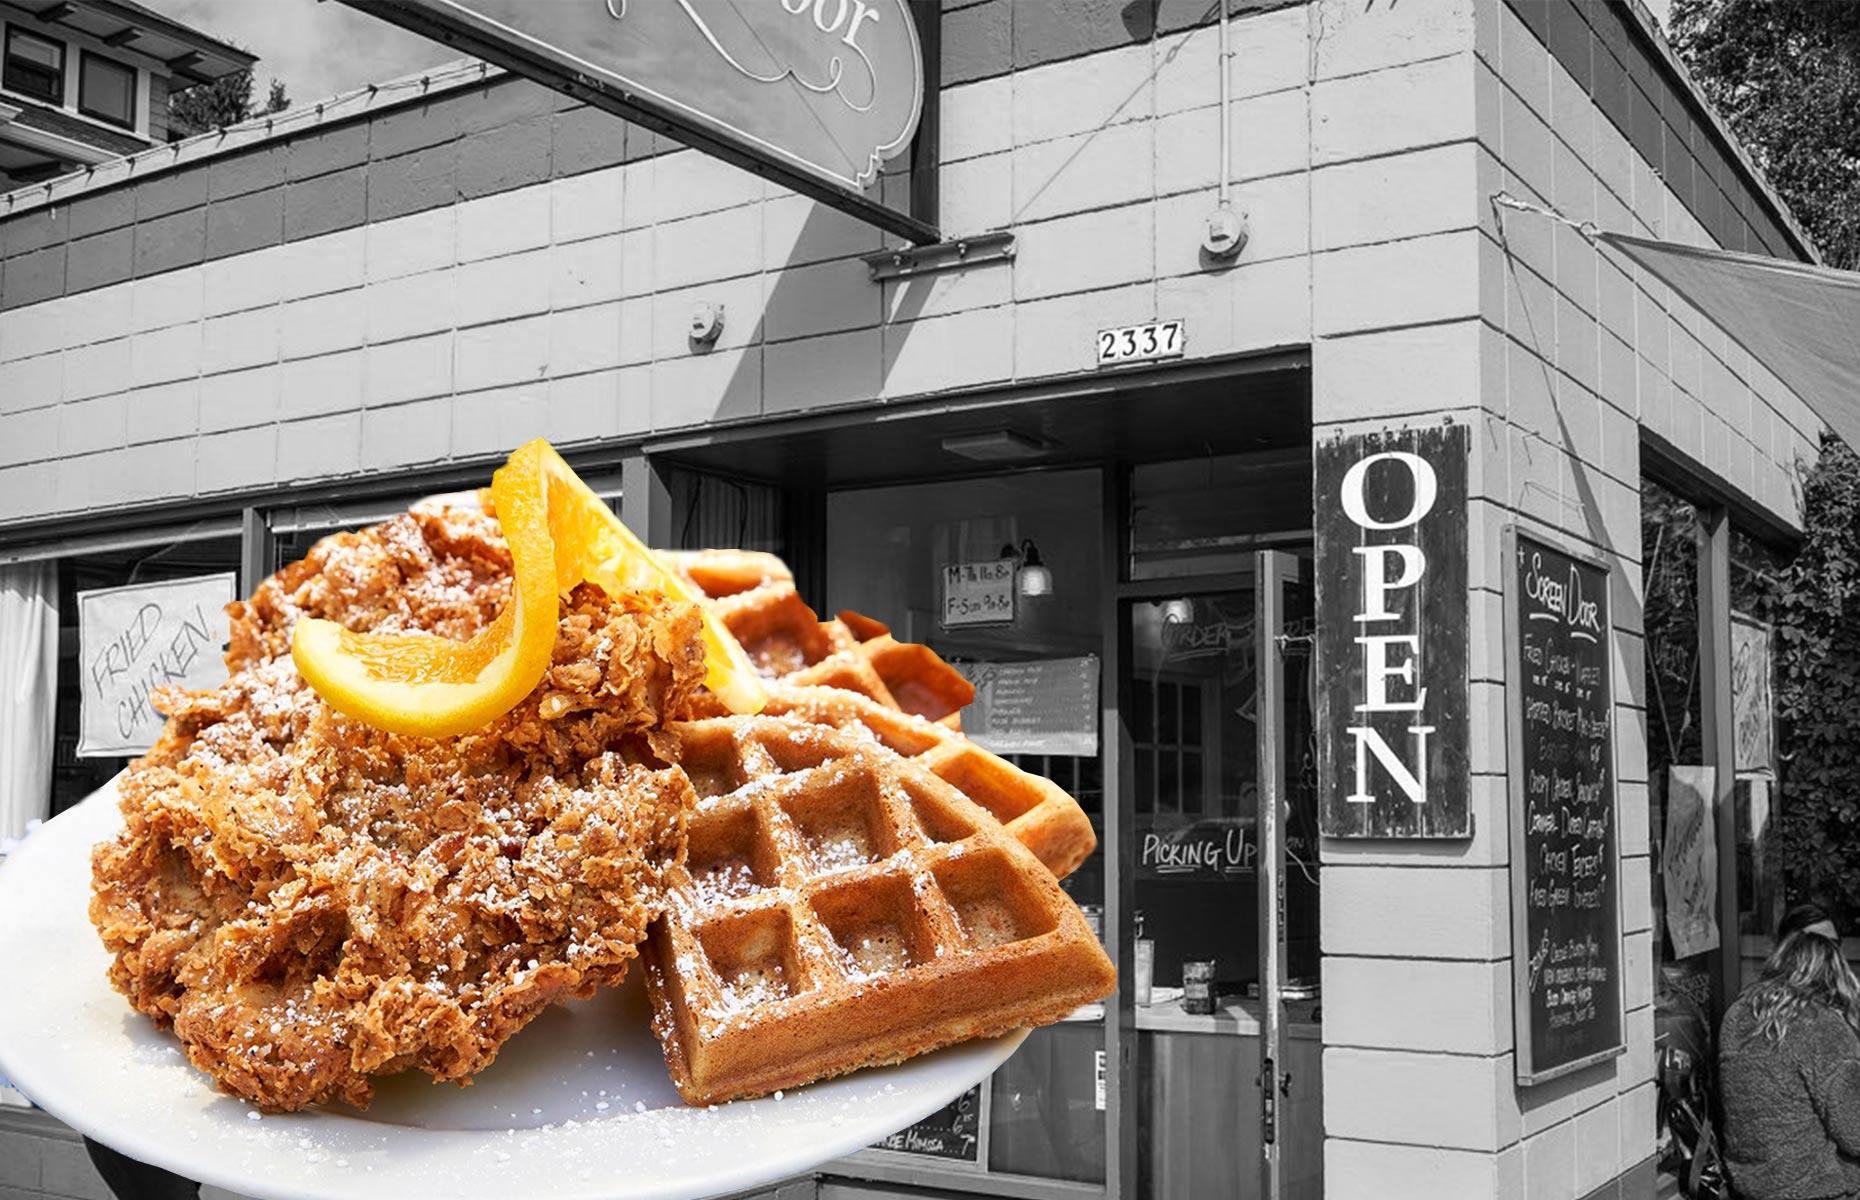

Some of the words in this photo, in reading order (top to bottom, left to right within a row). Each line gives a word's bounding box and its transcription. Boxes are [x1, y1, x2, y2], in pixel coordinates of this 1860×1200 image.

[1102, 323, 1178, 359] 2337
[1341, 451, 1438, 803] OPEN
[1525, 552, 1567, 617] SCREEN
[1567, 563, 1601, 634] DOOR
[92, 602, 163, 701] FRIED
[117, 604, 210, 740] CHICKEN
